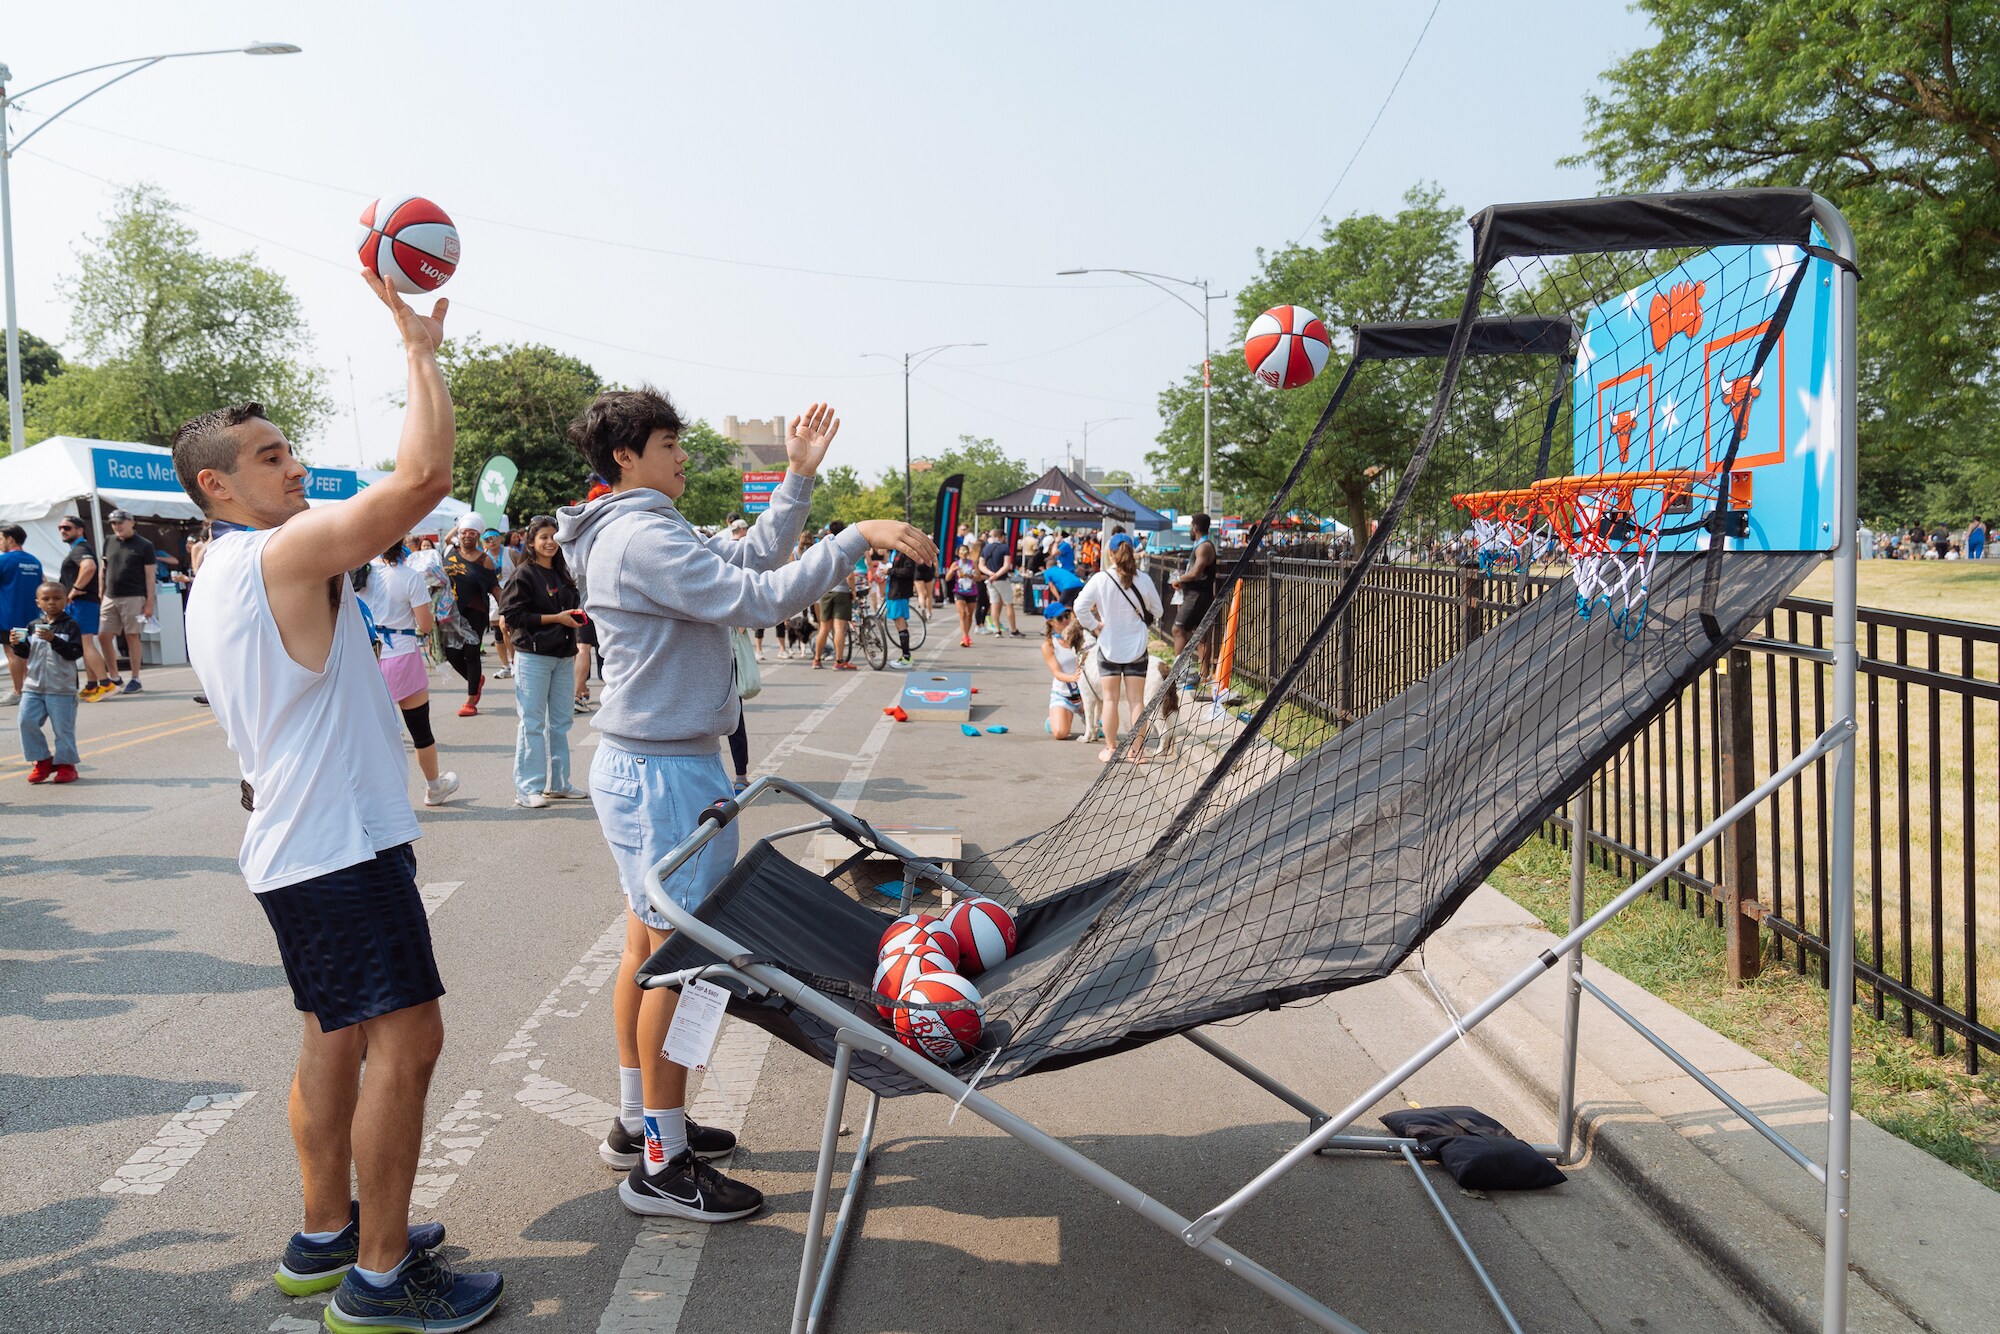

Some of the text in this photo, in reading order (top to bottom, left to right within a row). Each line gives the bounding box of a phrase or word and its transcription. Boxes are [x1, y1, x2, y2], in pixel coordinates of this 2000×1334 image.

[420, 262, 450, 286] lson
[108, 458, 144, 480] Race
[316, 476, 343, 492] FEET
[647, 1136, 665, 1163] NIKE
